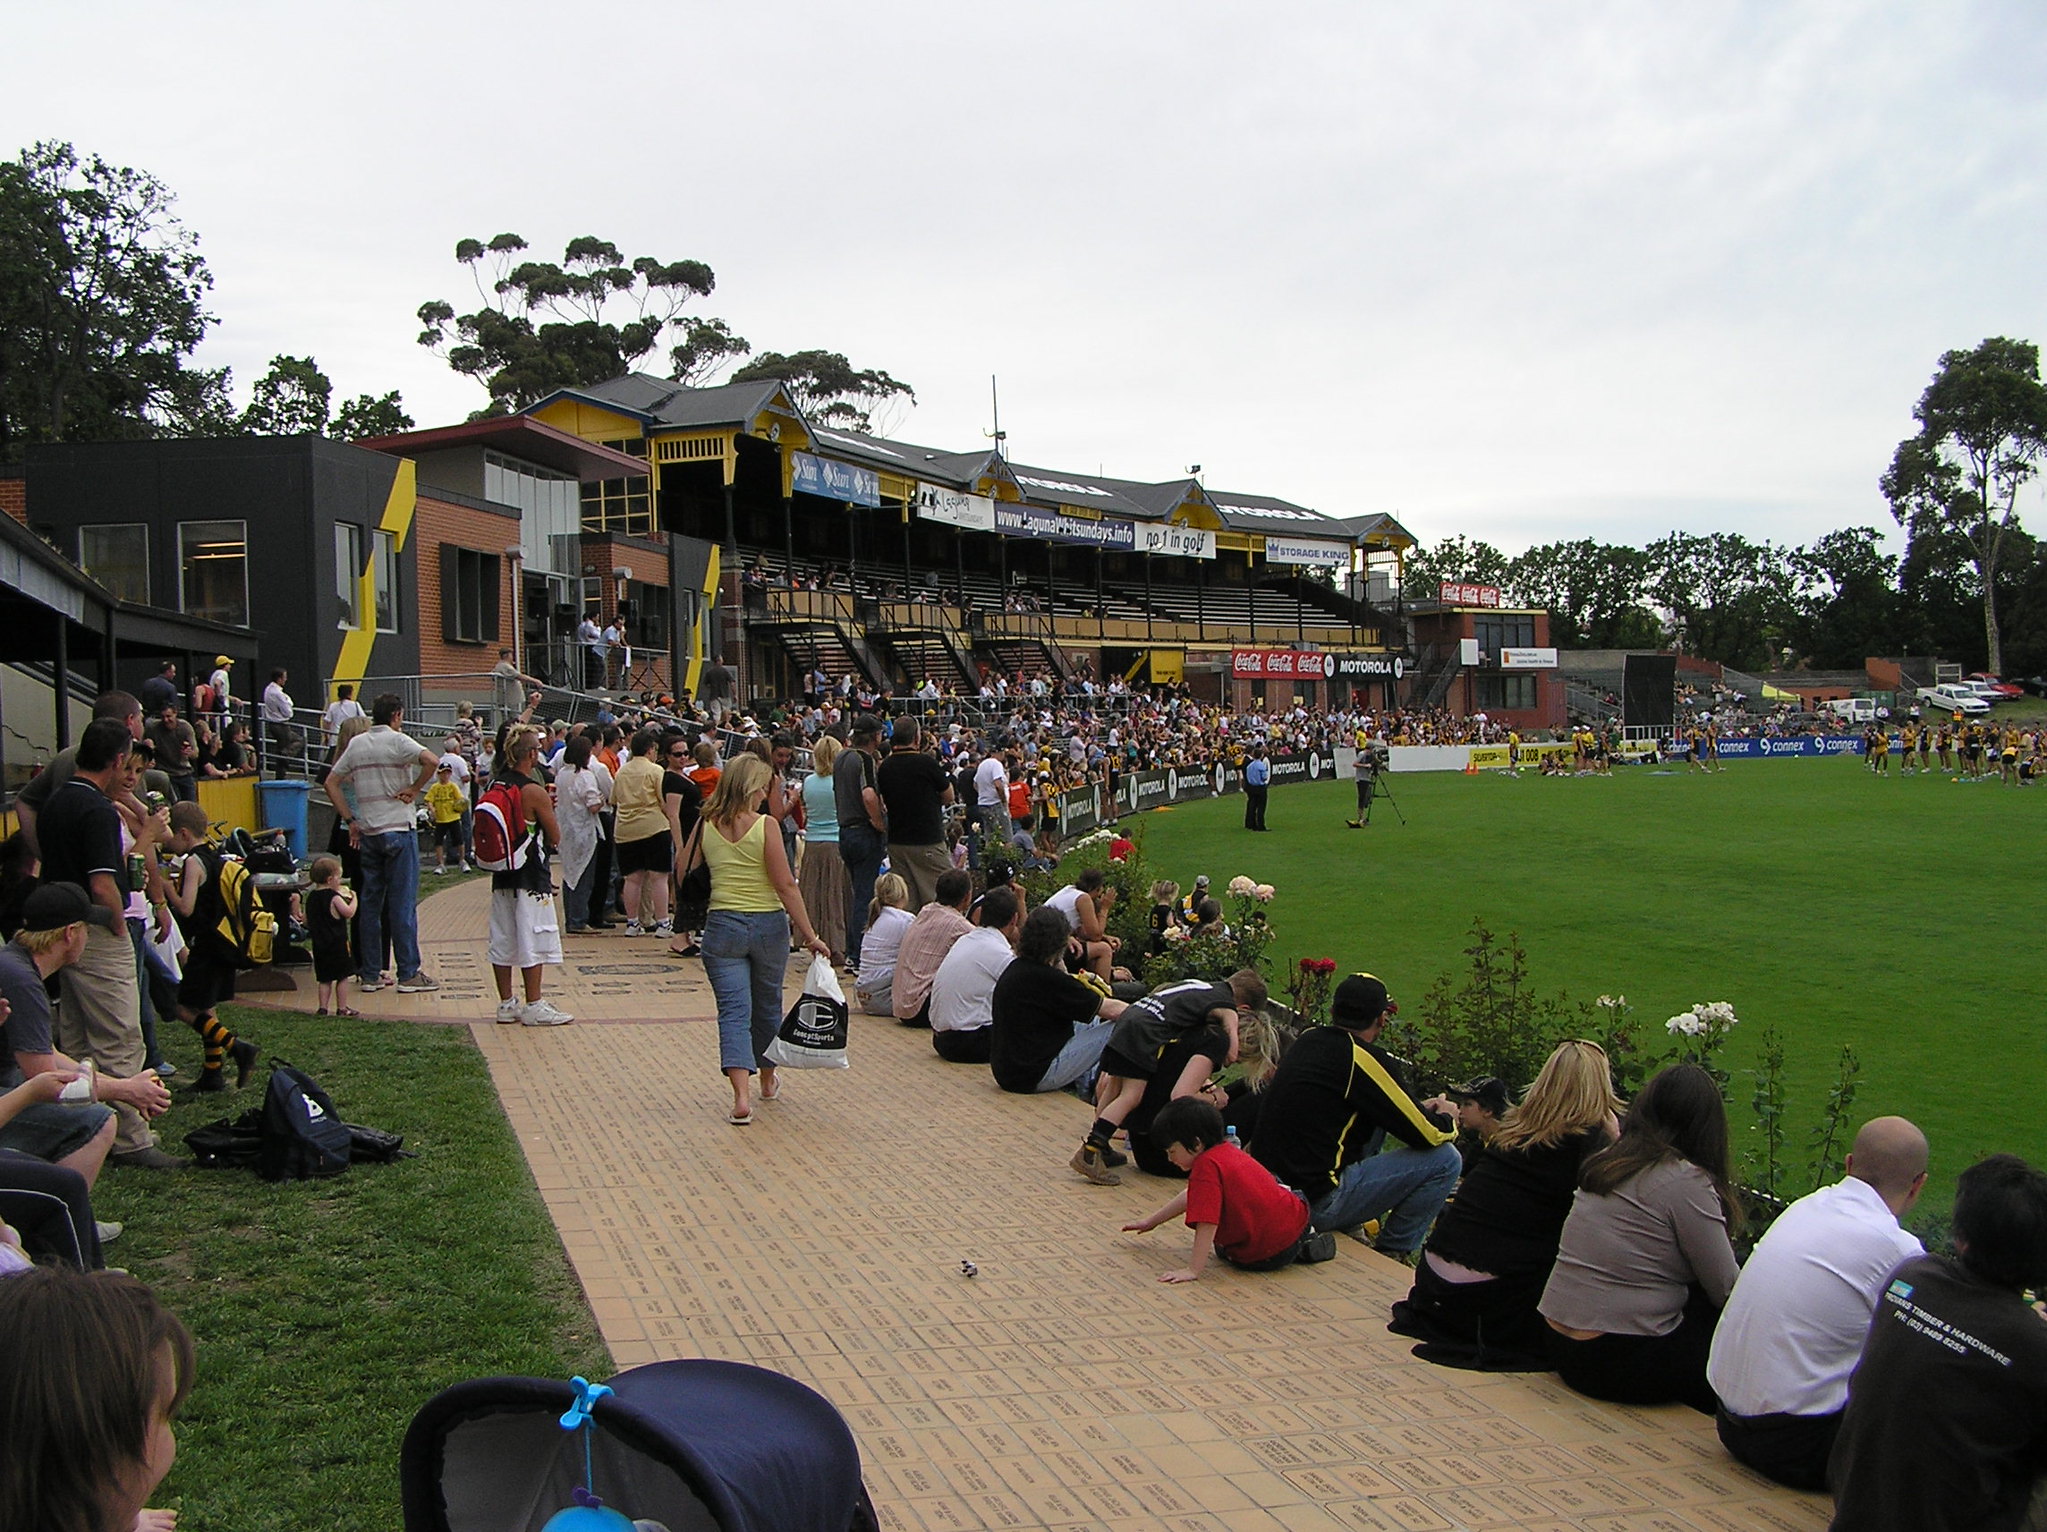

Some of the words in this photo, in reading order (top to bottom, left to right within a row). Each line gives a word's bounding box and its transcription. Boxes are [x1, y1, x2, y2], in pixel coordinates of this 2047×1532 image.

[801, 458, 817, 481] Sun
[833, 467, 849, 488] Sun
[1171, 530, 1180, 548] in
[1183, 533, 1205, 553] golf
[1280, 547, 1320, 559] STORAGE
[1322, 550, 1350, 560] KING
[1339, 660, 1391, 674] MOTOROLA
[1719, 742, 1750, 754] connex
[1772, 741, 1805, 752] connex
[1826, 740, 1858, 750] connex
[1526, 749, 1539, 762] 008
[1272, 762, 1306, 776] MOTOROLA
[1138, 779, 1166, 797] MOTOROLA
[1067, 798, 1093, 820] MOTOROLA
[1152, 913, 1159, 928] 6
[1906, 1317, 1923, 1332] (03)
[1912, 1305, 1944, 1328] TIMBER
[1942, 1325, 1951, 1333] &
[1950, 1327, 2011, 1366] HARDWARE
